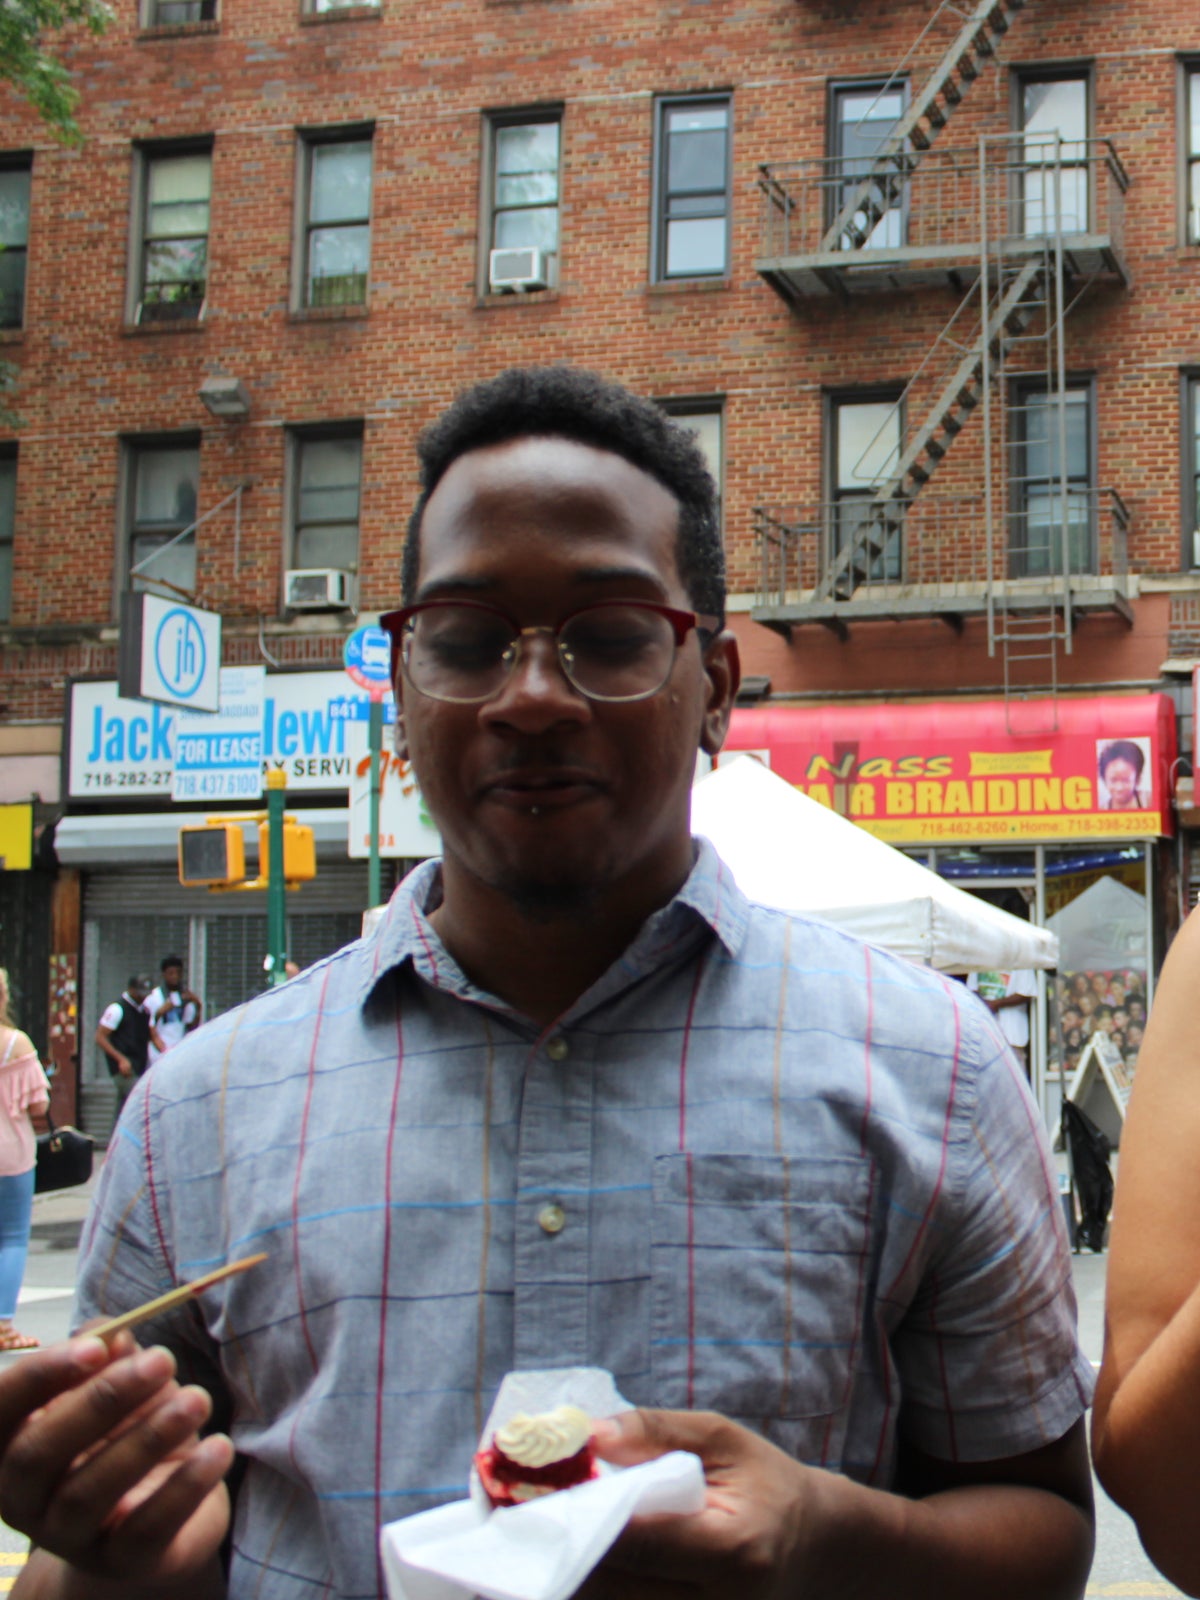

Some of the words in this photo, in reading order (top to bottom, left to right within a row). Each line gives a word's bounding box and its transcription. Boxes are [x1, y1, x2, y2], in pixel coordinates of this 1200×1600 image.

[87, 704, 173, 763] Jack
[177, 739, 207, 764] FOR
[210, 737, 260, 763] LEASE
[84, 771, 173, 787] 718-282-27
[294, 758, 350, 776] SERVI
[805, 752, 953, 780] Nass
[794, 782, 875, 816] AIR
[886, 776, 1092, 815] BRAIDING
